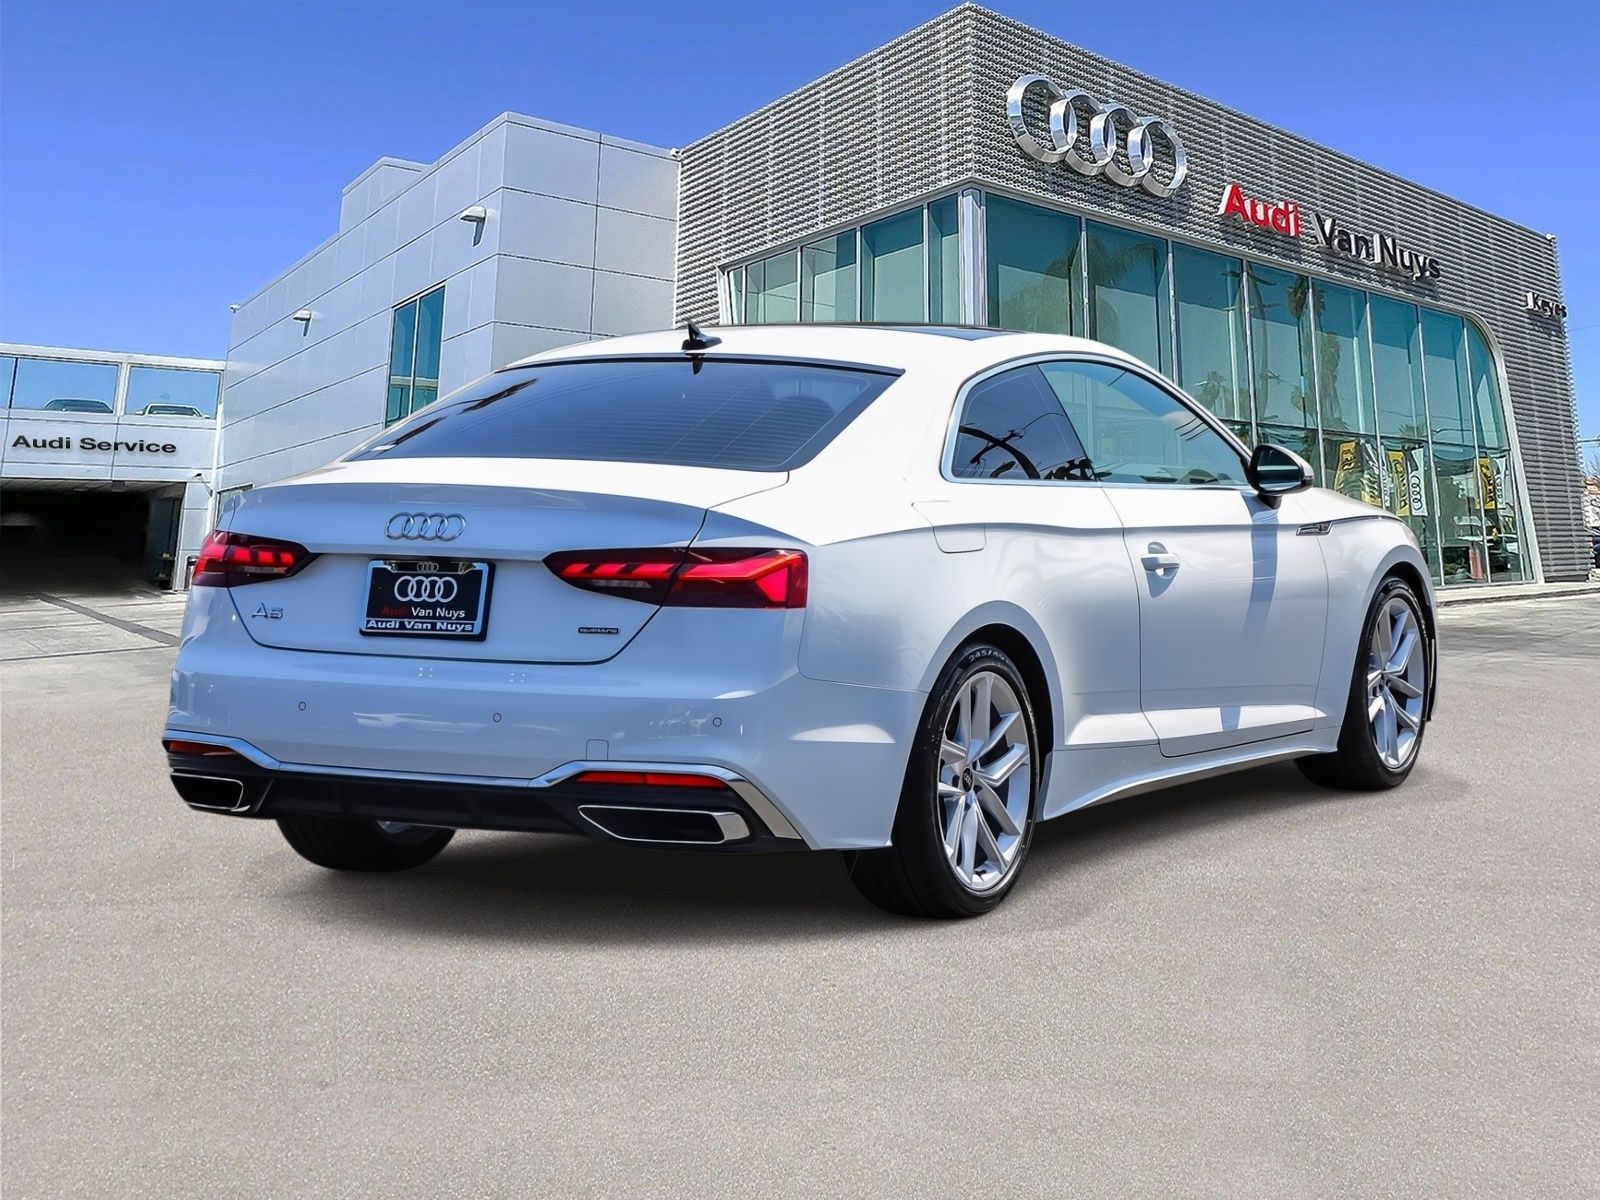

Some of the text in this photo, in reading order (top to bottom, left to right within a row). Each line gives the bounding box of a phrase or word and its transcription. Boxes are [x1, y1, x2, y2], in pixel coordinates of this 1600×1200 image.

[1217, 183, 1442, 281] Audi Van Nuys
[1526, 291, 1568, 318] Keyes
[11, 434, 178, 454] Audi Service
[251, 602, 284, 620] A5
[382, 605, 466, 620] Audi Van Nuys
[367, 619, 473, 634] Audi Van Nuys
